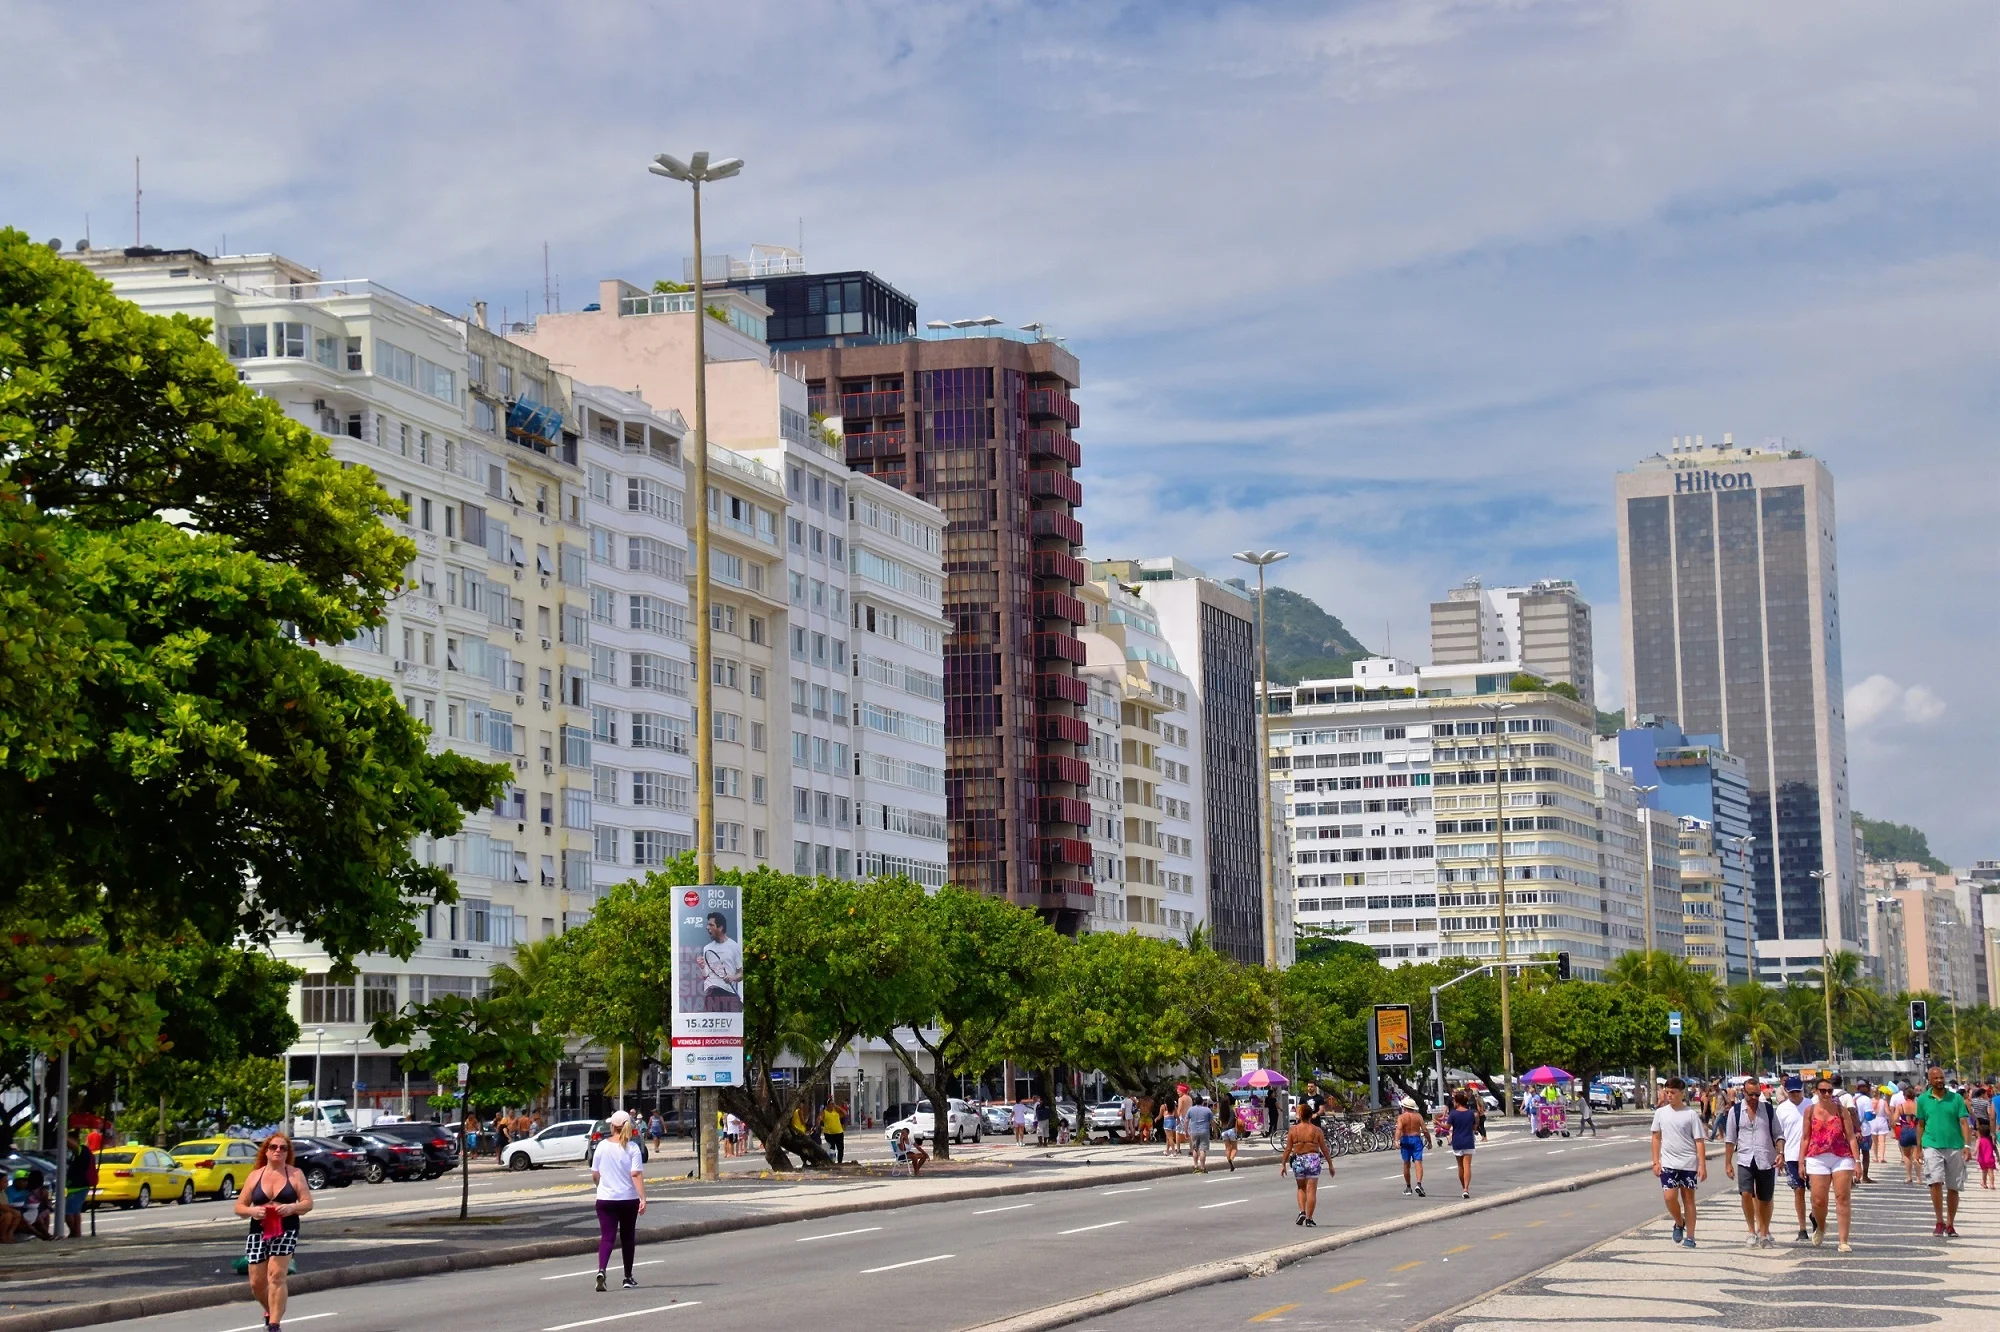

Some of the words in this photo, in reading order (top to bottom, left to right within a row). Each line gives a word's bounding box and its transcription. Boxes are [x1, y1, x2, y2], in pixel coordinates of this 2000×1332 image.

[1675, 470, 1753, 492] Hilton
[708, 890, 725, 899] RIO
[708, 899, 734, 909] OPEN
[686, 1019, 697, 1028] 15
[702, 1019, 714, 1028] 23
[715, 1019, 732, 1028] FEV
